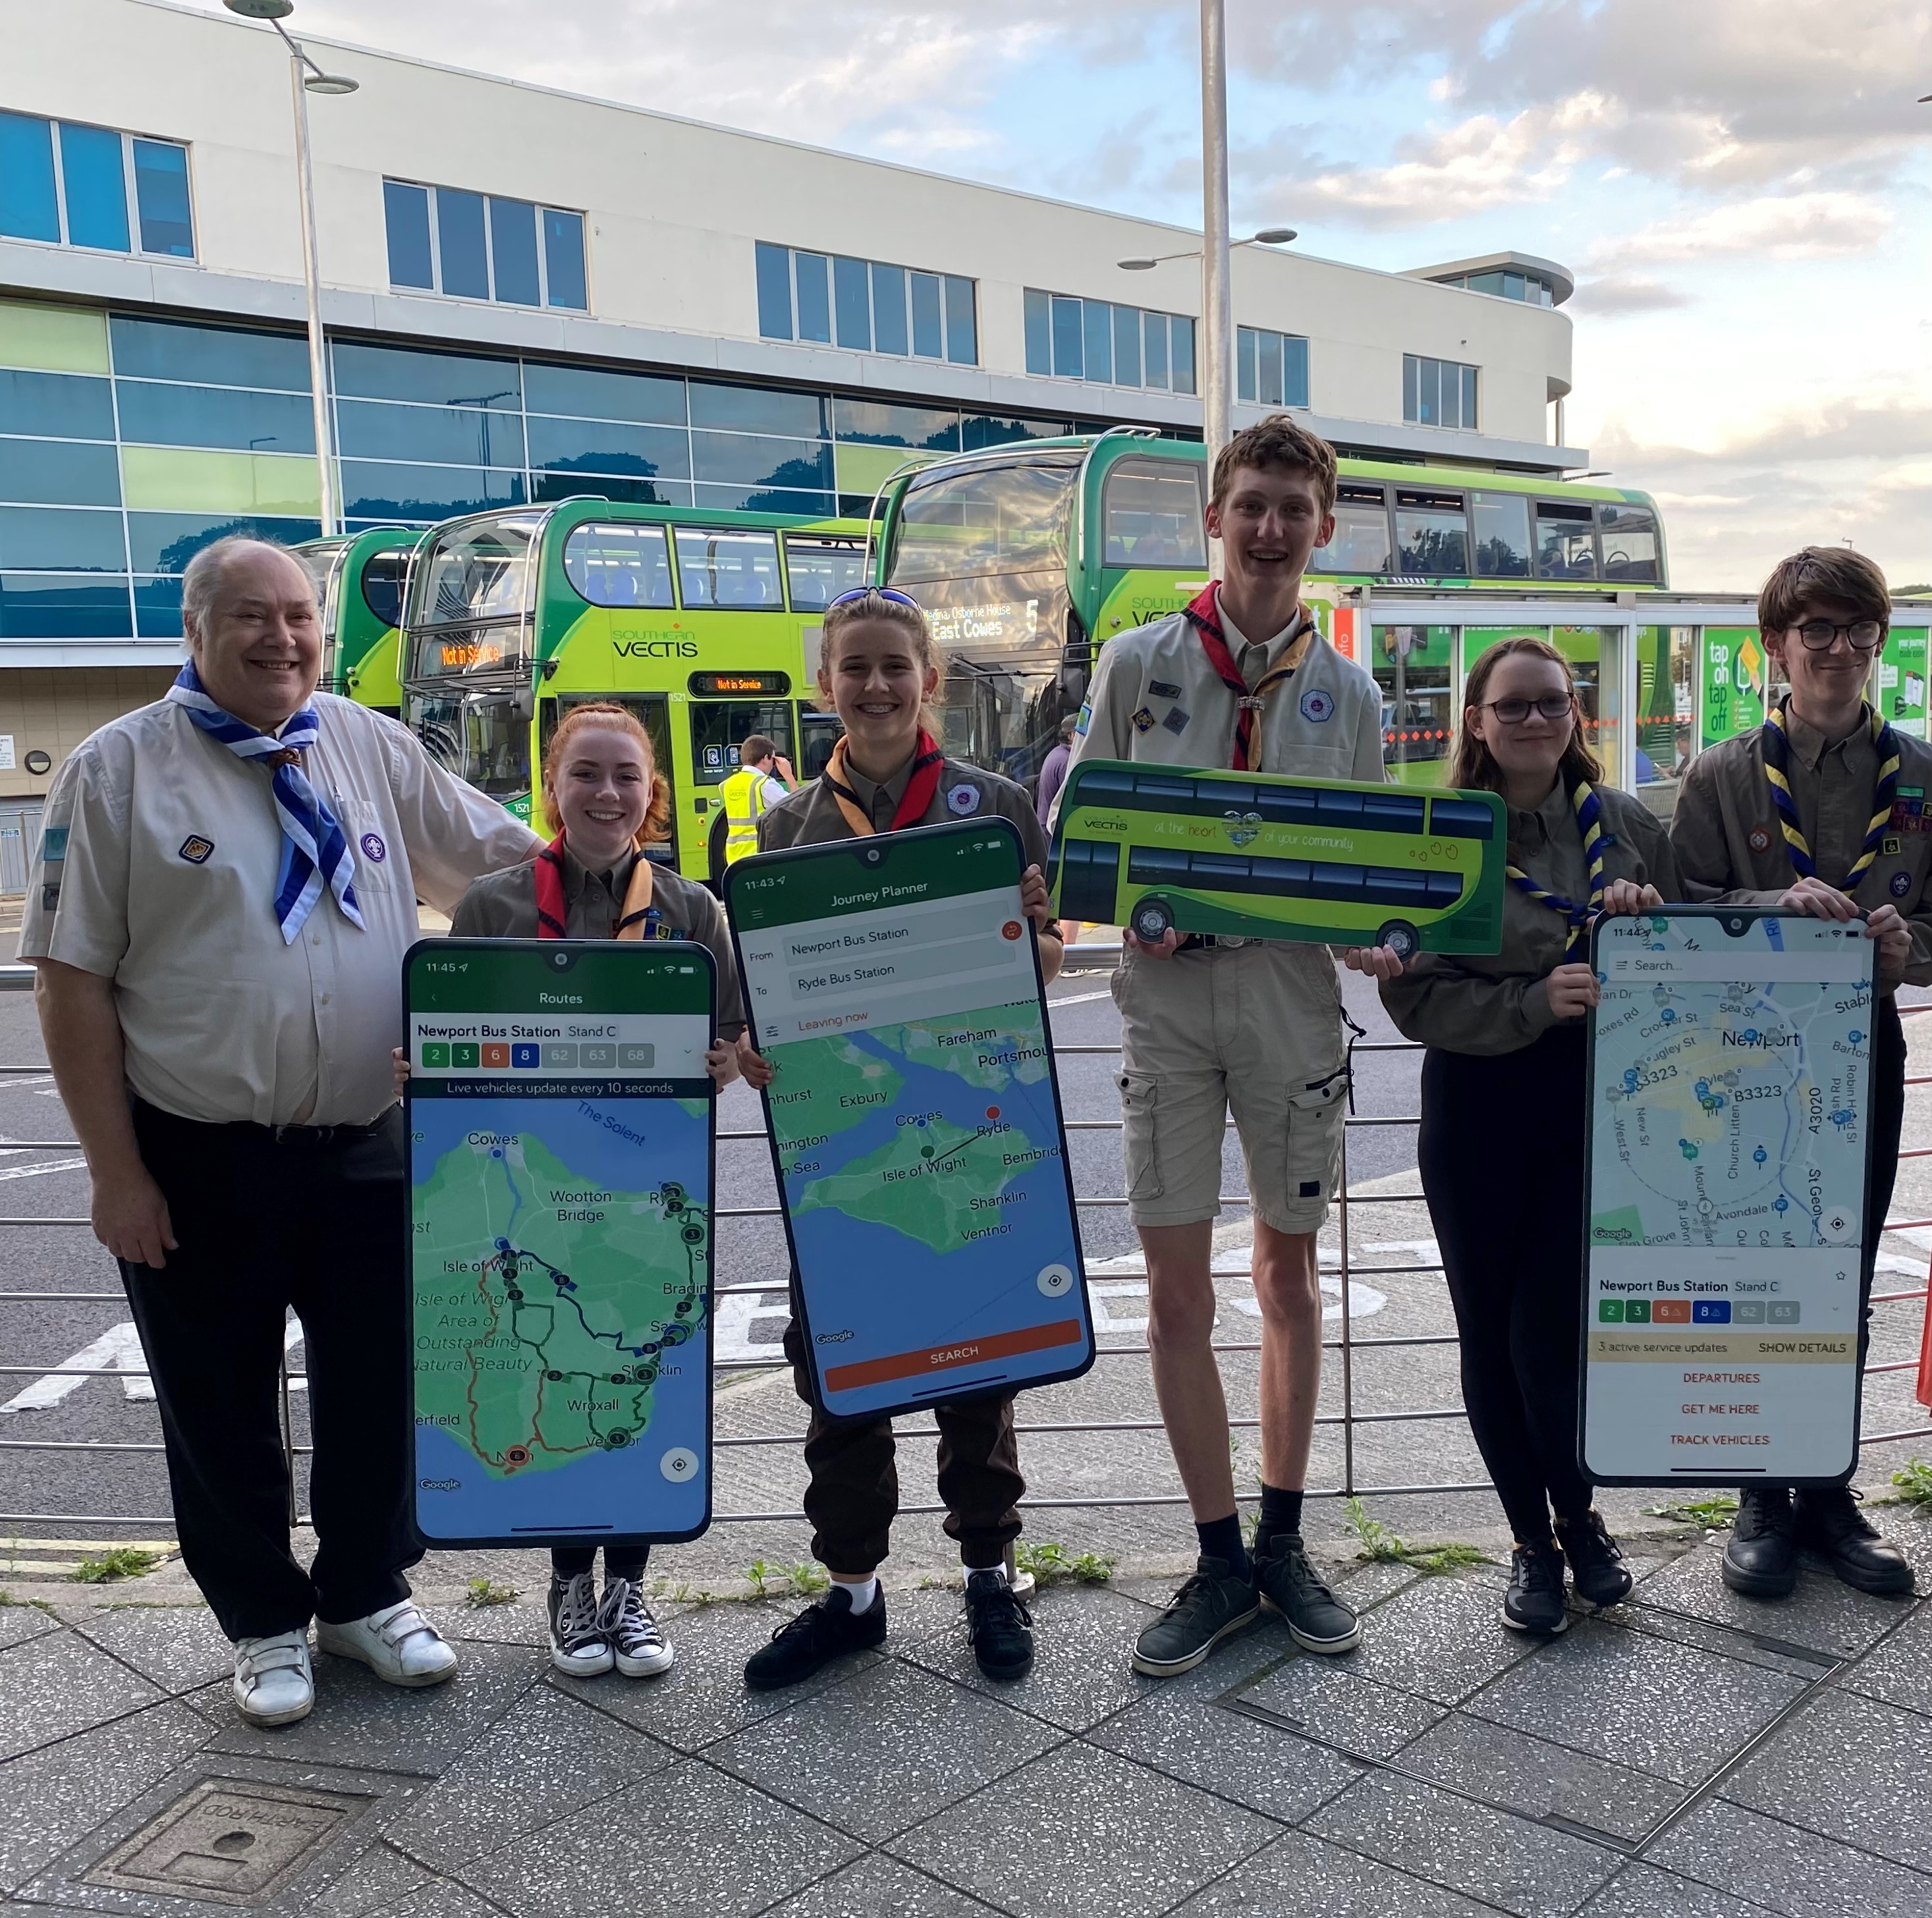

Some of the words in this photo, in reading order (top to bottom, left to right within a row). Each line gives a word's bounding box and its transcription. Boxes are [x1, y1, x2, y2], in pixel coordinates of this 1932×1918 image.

[1132, 597, 1190, 609] SOUTHE
[952, 606, 985, 619] Osborne
[986, 604, 1010, 616] House
[1026, 600, 1038, 633] 5
[613, 630, 696, 640] SOUTHERN
[932, 620, 960, 640] East
[964, 619, 1003, 638] Cowes
[613, 642, 698, 657] VECTIS
[1338, 633, 1349, 656] nfo
[441, 645, 456, 666] Not
[458, 645, 466, 665] in
[467, 644, 500, 663] Service
[1710, 641, 1728, 668] tap
[1714, 667, 1728, 684] on
[717, 679, 730, 690] Not
[731, 680, 738, 689] in
[739, 679, 761, 690] Service
[669, 693, 686, 701] 1521
[1709, 684, 1727, 712] tap
[1711, 707, 1727, 731] off
[514, 804, 530, 813] 1521
[1084, 820, 1128, 831] VECTIS
[1155, 823, 1165, 833] at
[1169, 823, 1184, 835] the
[1188, 825, 1217, 838] heart
[1265, 830, 1275, 842] of
[1279, 834, 1299, 846] your
[1302, 836, 1354, 852] community
[746, 878, 775, 890] 11:43
[831, 890, 879, 908] Journey
[881, 881, 928, 899] Planner
[792, 939, 841, 956] Newport
[844, 934, 866, 947] Bus
[869, 927, 909, 942] Station
[750, 950, 773, 961] From
[426, 963, 456, 972] 11:45
[798, 975, 827, 991] Ryde
[829, 971, 851, 985] Bus
[854, 964, 895, 979] Station
[539, 993, 583, 1004] Routes
[1620, 989, 1633, 999] Dr
[1719, 1003, 1741, 1013] Sea
[1742, 1007, 1755, 1019] St
[1835, 993, 1872, 1014] Stapl
[798, 1015, 842, 1032] Leaving
[845, 1011, 868, 1023] now
[1624, 1006, 1640, 1022] Rd
[418, 1025, 477, 1039] Newport
[482, 1026, 507, 1037] Bus
[511, 1026, 560, 1037] Station
[568, 1026, 601, 1037] Stand
[603, 1026, 616, 1037] C
[1640, 1016, 1682, 1038] Crocer
[1686, 1013, 1698, 1022] St
[937, 1028, 997, 1047] Fareham
[431, 1049, 439, 1060] 2
[461, 1050, 469, 1060] 3
[491, 1050, 500, 1060] 6
[521, 1051, 530, 1060] 8
[551, 1050, 568, 1060] 62
[589, 1050, 606, 1060] 63
[628, 1050, 644, 1060] 68
[1653, 1043, 1680, 1062] ugley
[1683, 1037, 1696, 1047] St
[1832, 1041, 1869, 1060] Barton
[1831, 1078, 1841, 1093] Rd
[1846, 1065, 1857, 1096] Robin
[447, 1082, 471, 1093] Live
[475, 1082, 522, 1093] vehicles
[526, 1083, 567, 1095] update
[571, 1085, 602, 1096] every
[607, 1083, 621, 1093] 10
[625, 1083, 673, 1093] seconds
[1734, 1085, 1782, 1102] B3323
[840, 1090, 888, 1109] Exbury
[1808, 1087, 1823, 1134] A3020
[576, 1100, 602, 1122] The
[603, 1118, 646, 1147] Solent
[1636, 1107, 1646, 1132] New
[1730, 1105, 1740, 1136] Litten
[977, 1122, 1010, 1138] Ryde
[1615, 1120, 1627, 1147] West
[468, 1132, 518, 1145] Cowes
[1619, 1151, 1630, 1162] St
[1728, 1138, 1740, 1179] Church
[794, 1162, 820, 1174] Sea
[883, 1169, 906, 1182] Isle
[909, 1165, 922, 1177] of
[927, 1157, 967, 1174] Wight
[1808, 1168, 1821, 1183] St
[550, 1190, 611, 1202] Wootton
[970, 1191, 1027, 1210] Shanklin
[558, 1210, 604, 1223] Bridge
[1716, 1204, 1769, 1220] Avondale
[960, 1223, 1012, 1242] Ventnor
[1594, 1227, 1632, 1241] Google
[1643, 1232, 1676, 1246] Grove
[443, 1261, 468, 1272] Isle
[472, 1260, 485, 1272] of
[1600, 1280, 1653, 1292] Newport
[1657, 1281, 1679, 1292] Bus
[1684, 1281, 1728, 1292] Station
[1735, 1282, 1767, 1292] Stand
[1771, 1282, 1779, 1292] C
[414, 1293, 443, 1305] Isle
[449, 1292, 466, 1305] of
[472, 1292, 508, 1307] Wig
[1607, 1306, 1615, 1315] 2
[1634, 1306, 1642, 1316] 3
[1661, 1306, 1669, 1316] 6
[1701, 1307, 1709, 1317] 8
[1740, 1307, 1757, 1317] 62
[1775, 1307, 1791, 1317] 63
[437, 1315, 476, 1327] Area
[483, 1314, 500, 1327] of
[416, 1336, 520, 1351] Outstanding
[816, 1329, 854, 1344] Google
[931, 1346, 980, 1364] SEARCH
[1598, 1342, 1605, 1352] 3
[1608, 1342, 1640, 1352] active
[1643, 1343, 1682, 1352] service
[1685, 1343, 1728, 1355] updates
[1759, 1343, 1796, 1353] SHOW
[1799, 1343, 1846, 1353] DETAILS
[474, 1357, 532, 1373] Beauty
[1683, 1373, 1760, 1383] DEPARTURES
[567, 1399, 619, 1411] Wroxall
[1682, 1405, 1704, 1414] GET
[1709, 1404, 1726, 1414] ME
[1729, 1404, 1759, 1414] HERE
[1670, 1435, 1709, 1445] TRACK
[1713, 1435, 1770, 1445] VEHICLES
[420, 1479, 460, 1491] Google
[204, 1805, 244, 1820] ROD
